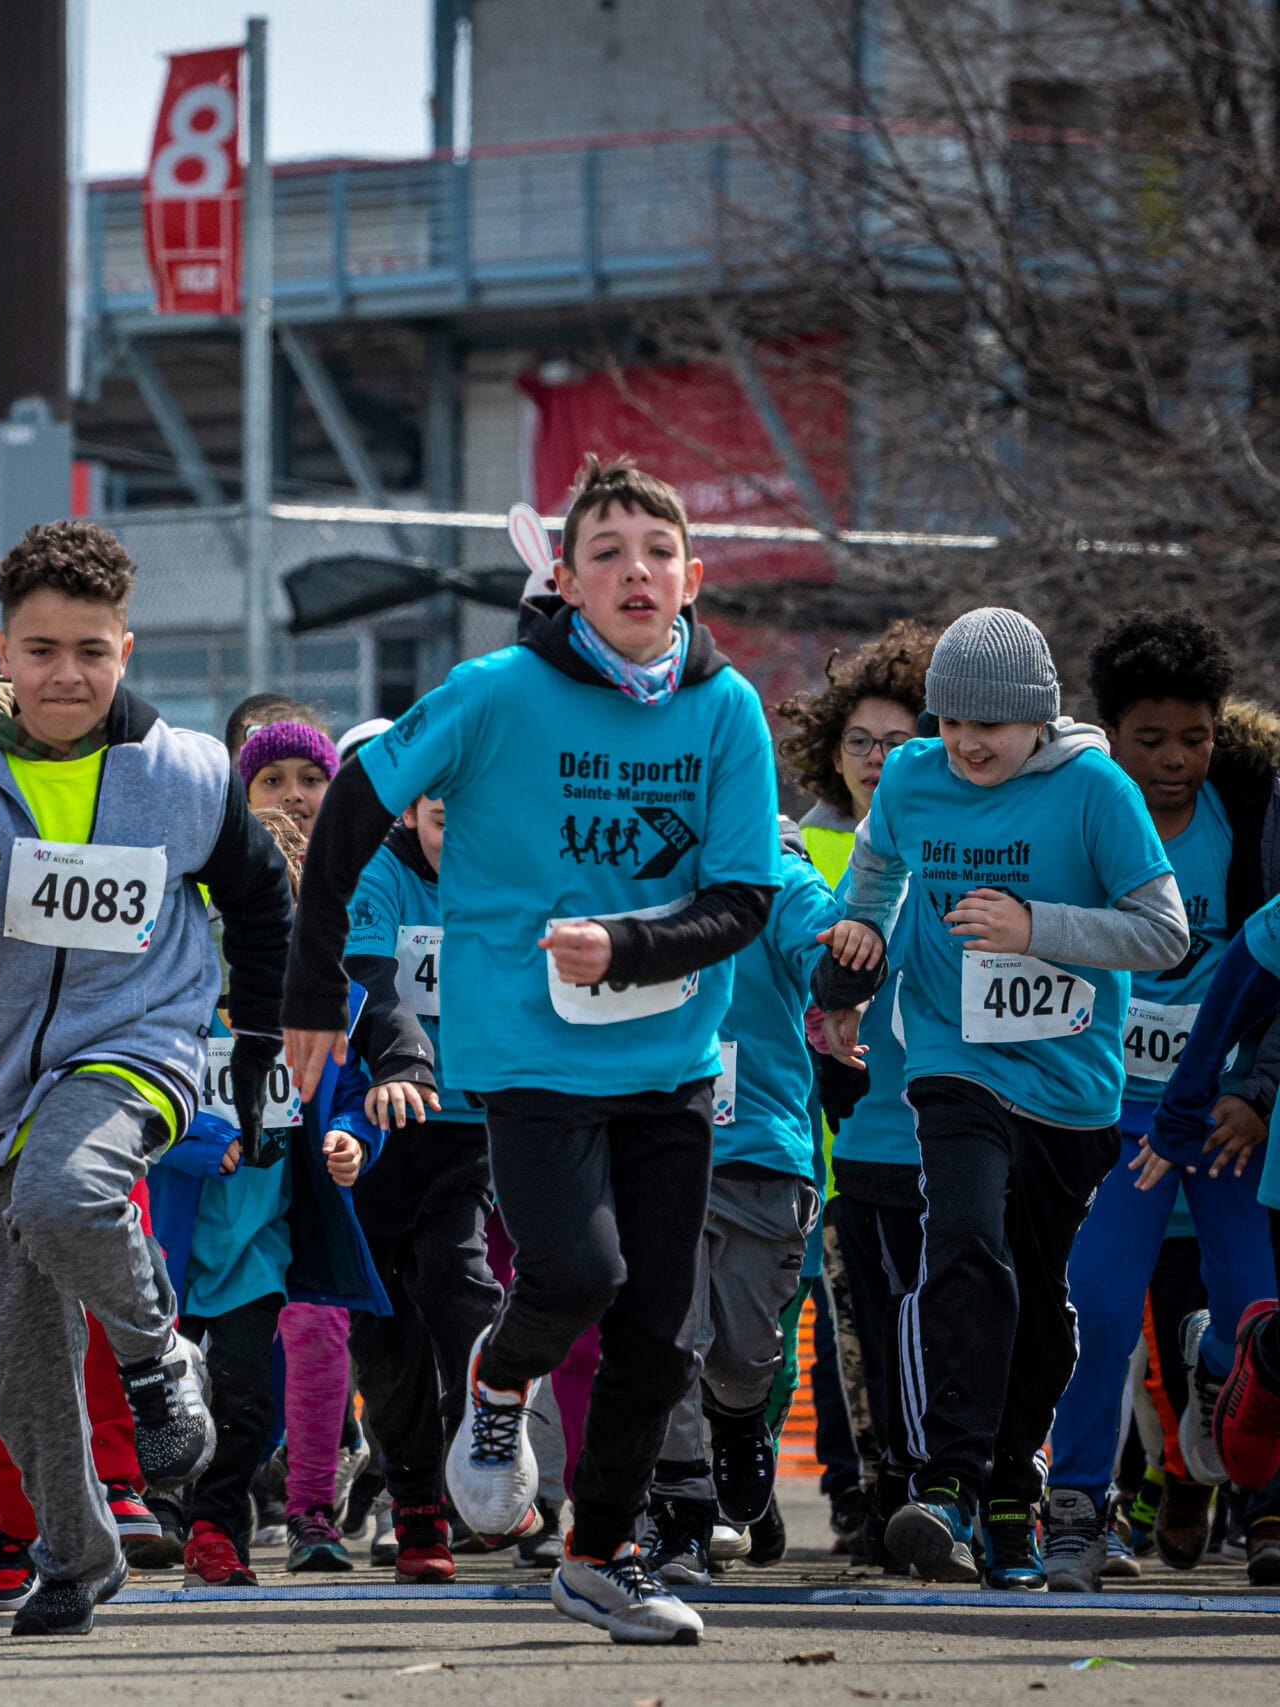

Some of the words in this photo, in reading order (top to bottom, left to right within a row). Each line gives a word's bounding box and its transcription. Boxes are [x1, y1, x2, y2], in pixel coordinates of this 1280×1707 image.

[559, 751, 610, 780] Défi
[618, 752, 703, 787] sportif
[562, 783, 696, 804] Sainte-Marguerite
[653, 811, 691, 850] 2023
[922, 840, 957, 864] Défi
[962, 839, 1031, 870] sportif
[922, 867, 1030, 885] Sainte-Marguerite
[31, 872, 147, 926] 4083
[983, 974, 1077, 1019] 4027
[131, 1373, 164, 1388] FASHION
